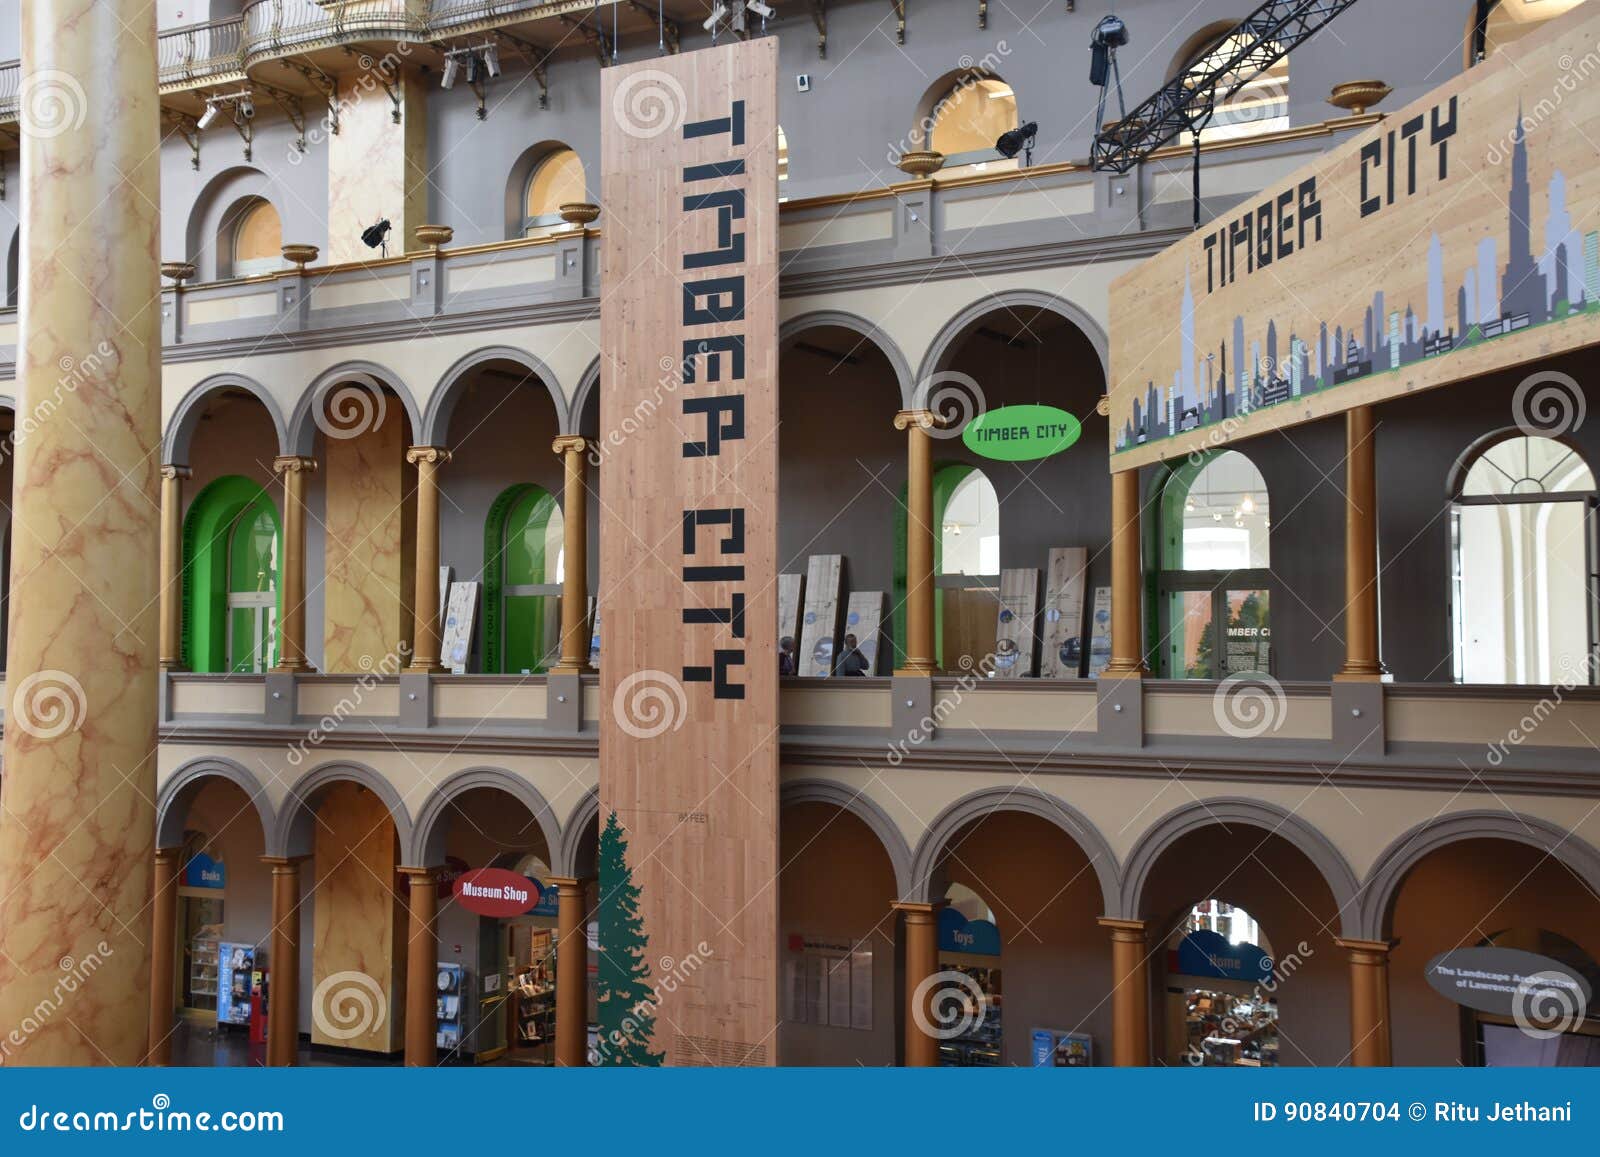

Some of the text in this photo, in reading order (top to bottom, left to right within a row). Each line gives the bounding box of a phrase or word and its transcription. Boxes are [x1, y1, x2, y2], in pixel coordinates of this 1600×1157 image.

[1203, 95, 1458, 294] TIMBER CITY
[683, 99, 745, 700] TIMBER CITY
[976, 423, 1067, 442] TIMBER CITY
[462, 881, 502, 899] Museum
[503, 885, 528, 904] Shop
[952, 929, 975, 946] Toys
[1208, 953, 1241, 970] Home
[1437, 965, 1455, 976] The
[1456, 968, 1510, 982] Landscape
[1456, 979, 1467, 988] of
[1468, 980, 1517, 993] Lawrence
